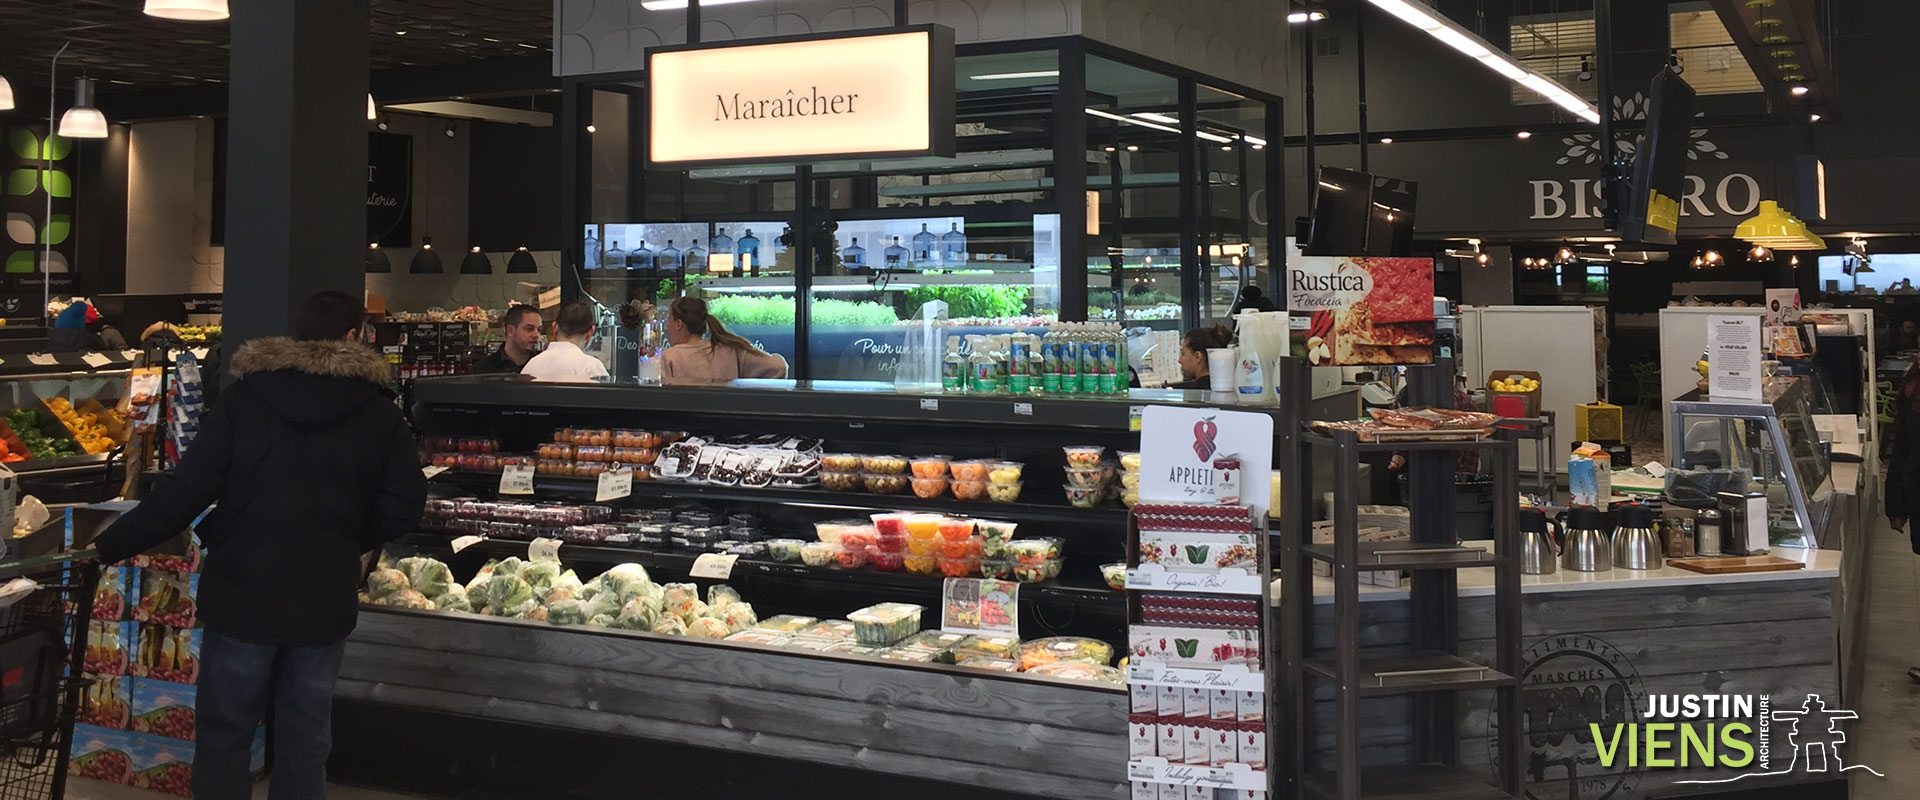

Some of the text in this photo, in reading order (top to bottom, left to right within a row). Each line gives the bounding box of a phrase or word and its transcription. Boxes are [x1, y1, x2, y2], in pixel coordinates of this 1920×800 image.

[714, 86, 859, 121] Maraîcher
[1528, 173, 1761, 220] BIRO
[1291, 266, 1364, 292] Rustica
[854, 338, 893, 355] Pour
[1169, 466, 1213, 486] APPLETI
[1166, 573, 1203, 589] Organic!
[1204, 574, 1228, 588] Bio!
[1532, 670, 1605, 685] MARCHÉS
